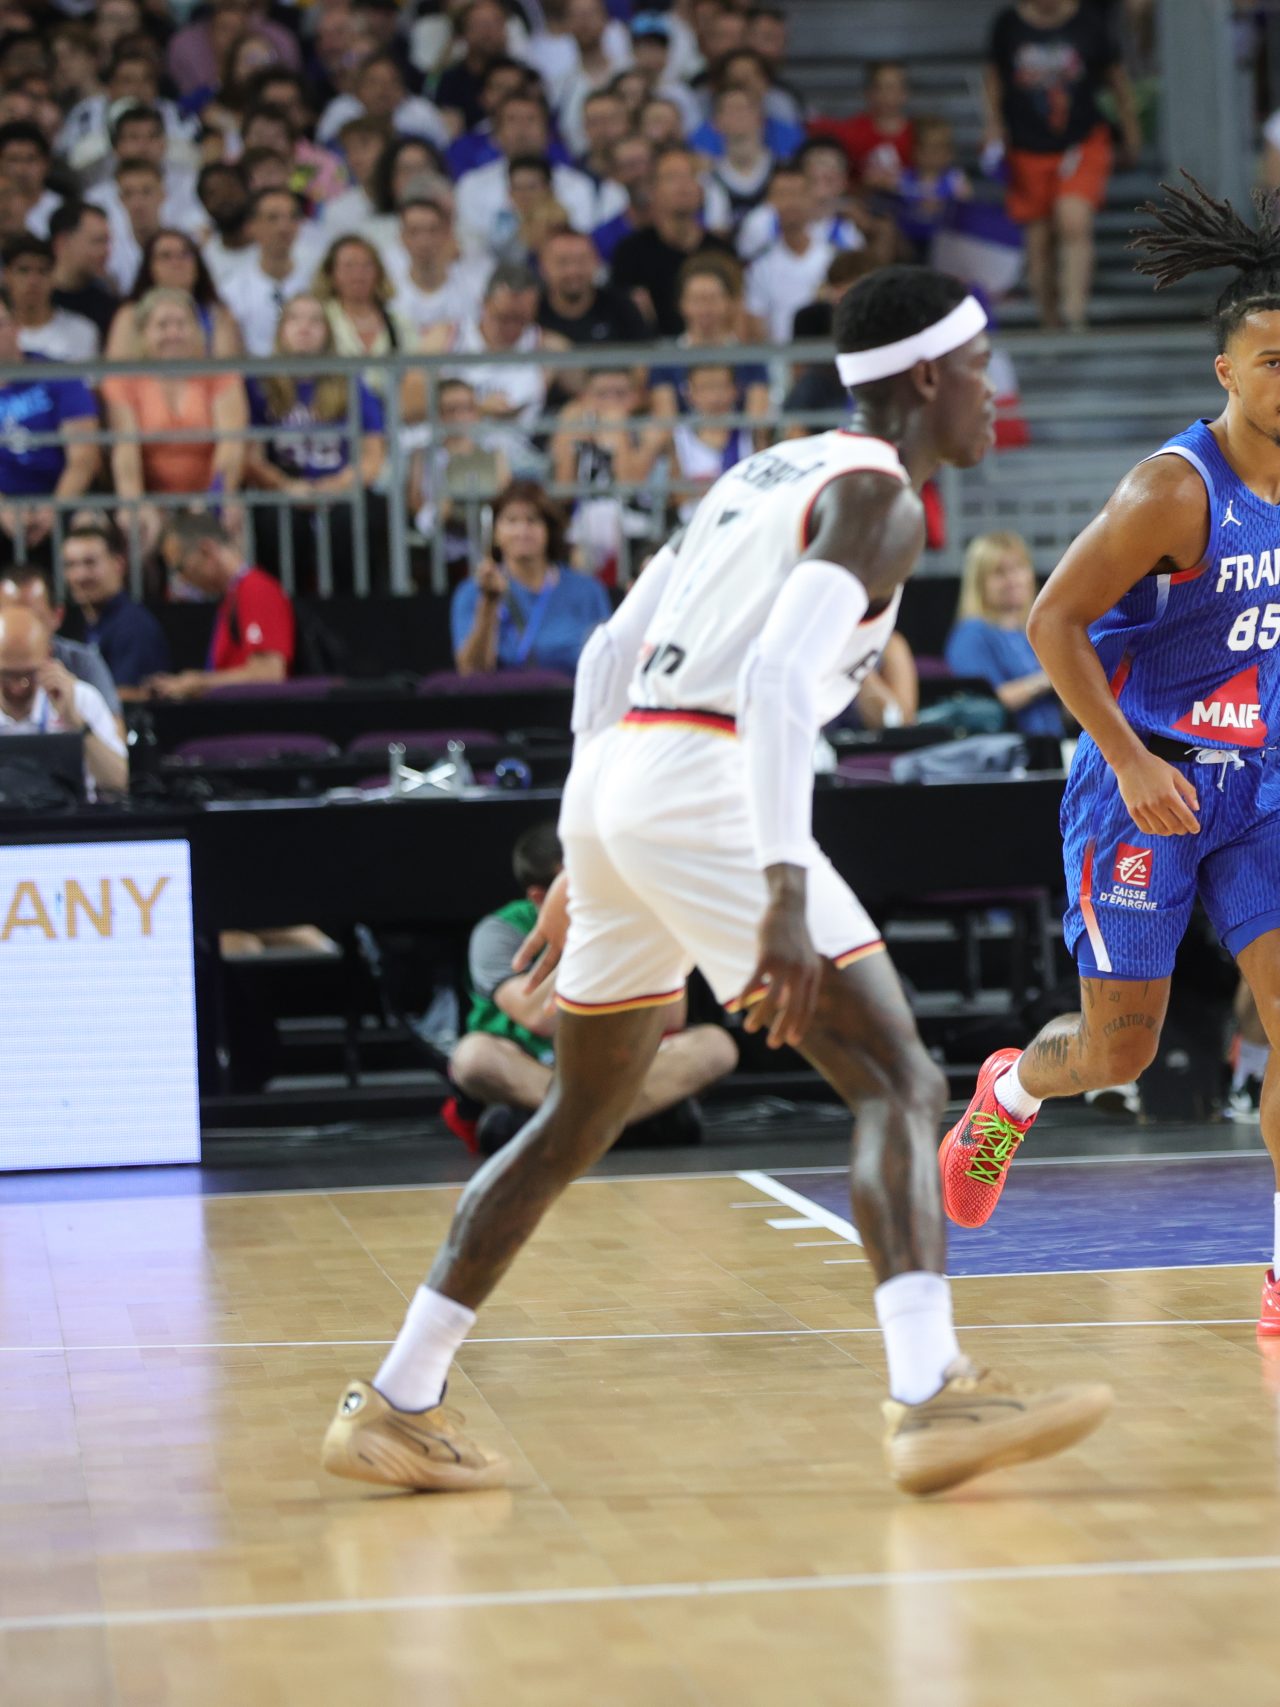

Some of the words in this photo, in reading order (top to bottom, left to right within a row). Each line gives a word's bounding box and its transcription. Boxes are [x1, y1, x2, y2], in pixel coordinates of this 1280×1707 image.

[1191, 700, 1262, 729] MAIF
[1112, 885, 1148, 901] CAISSE
[0, 876, 172, 941] ANY
